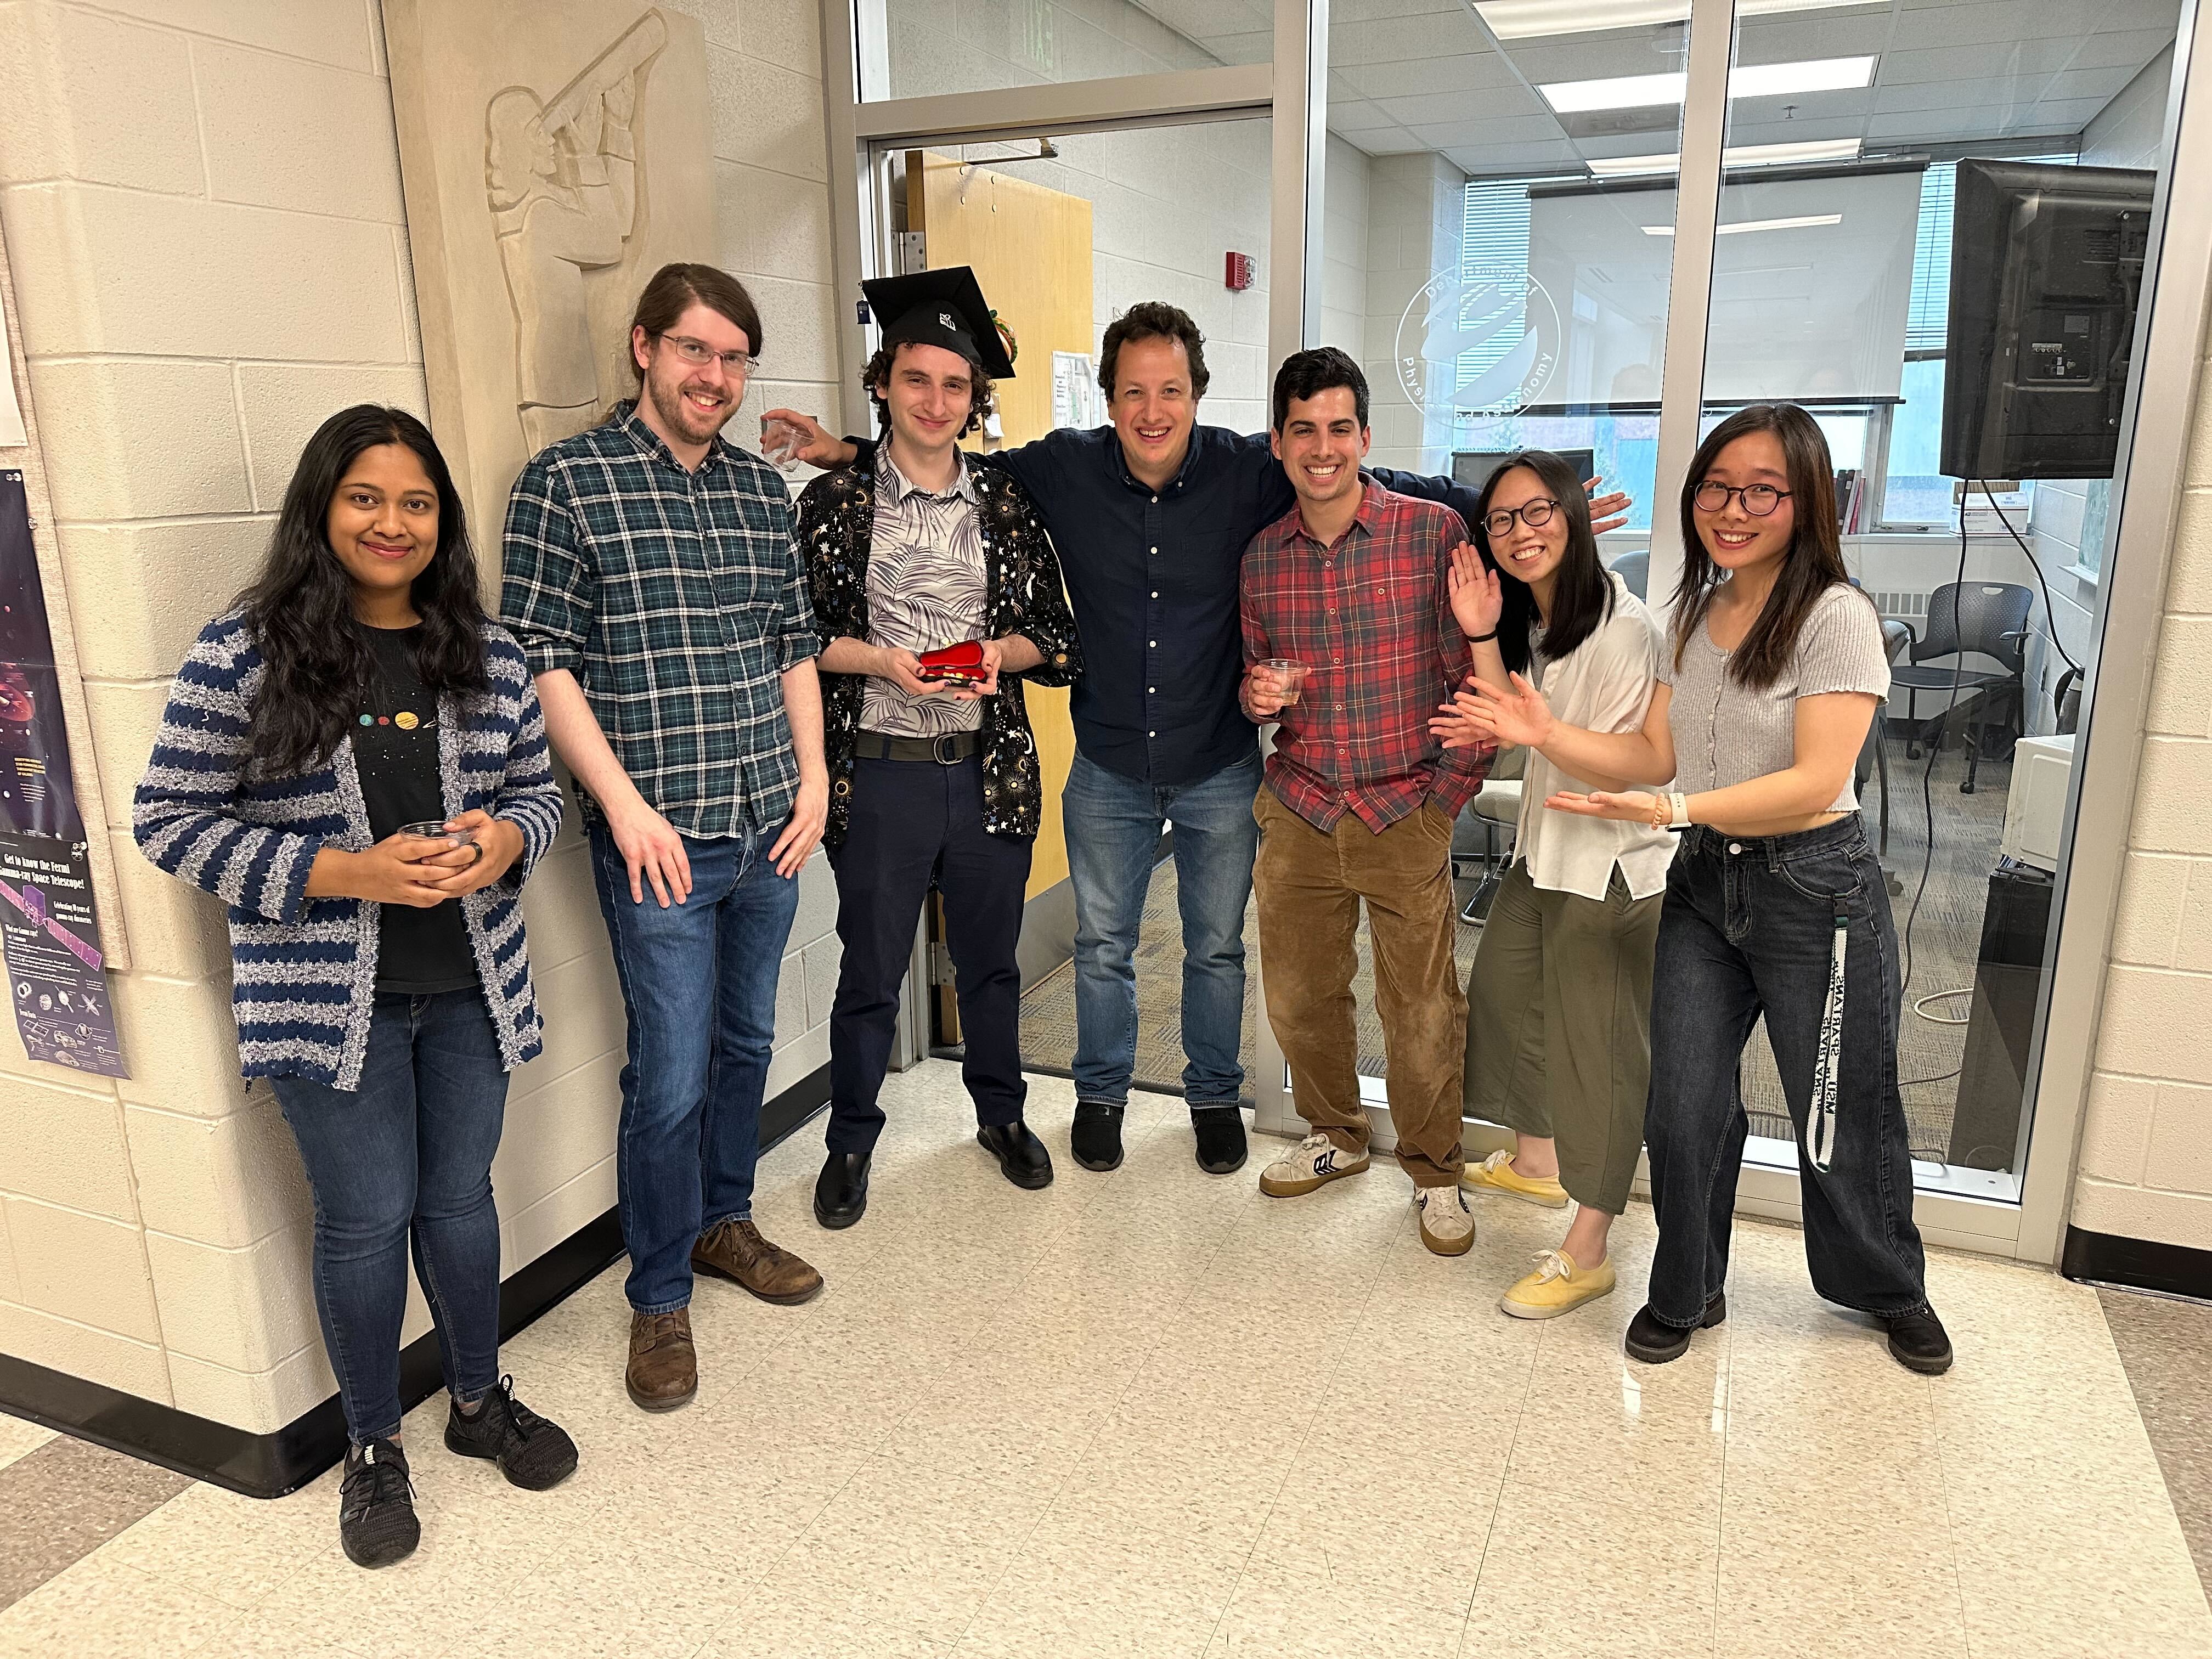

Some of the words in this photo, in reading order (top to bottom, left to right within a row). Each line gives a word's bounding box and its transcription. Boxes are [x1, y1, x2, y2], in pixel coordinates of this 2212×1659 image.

[1425, 266, 1518, 299] Deprtment
[1521, 283, 1538, 296] of
[1403, 357, 1440, 410] Physi
[1482, 352, 1553, 421] Astronomy
[4, 854, 14, 865] Get
[15, 856, 21, 866] to
[21, 857, 38, 868] know
[40, 860, 50, 871] the
[50, 861, 70, 874] Fermi
[31, 872, 50, 884] Space
[50, 874, 84, 889] Telescope!
